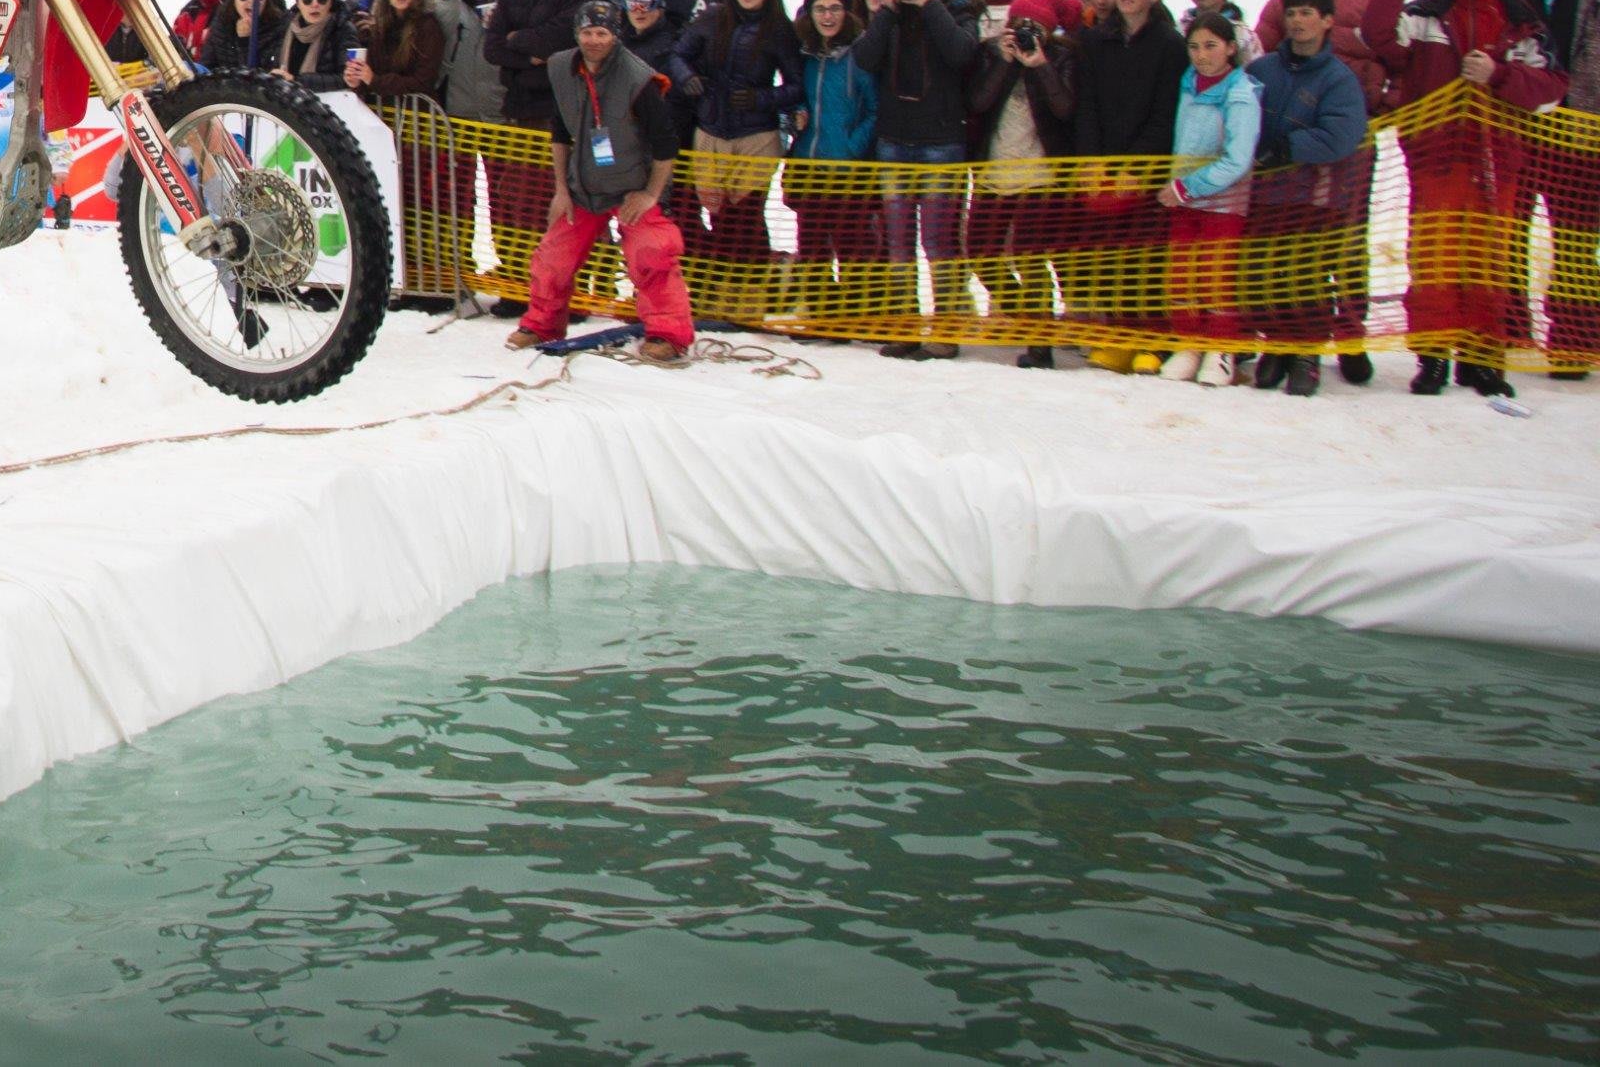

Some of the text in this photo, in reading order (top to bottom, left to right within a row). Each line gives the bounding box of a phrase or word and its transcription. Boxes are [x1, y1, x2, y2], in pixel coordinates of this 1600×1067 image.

[133, 125, 196, 212] DUNLOP
[299, 167, 332, 193] IN
[310, 195, 334, 209] OX
